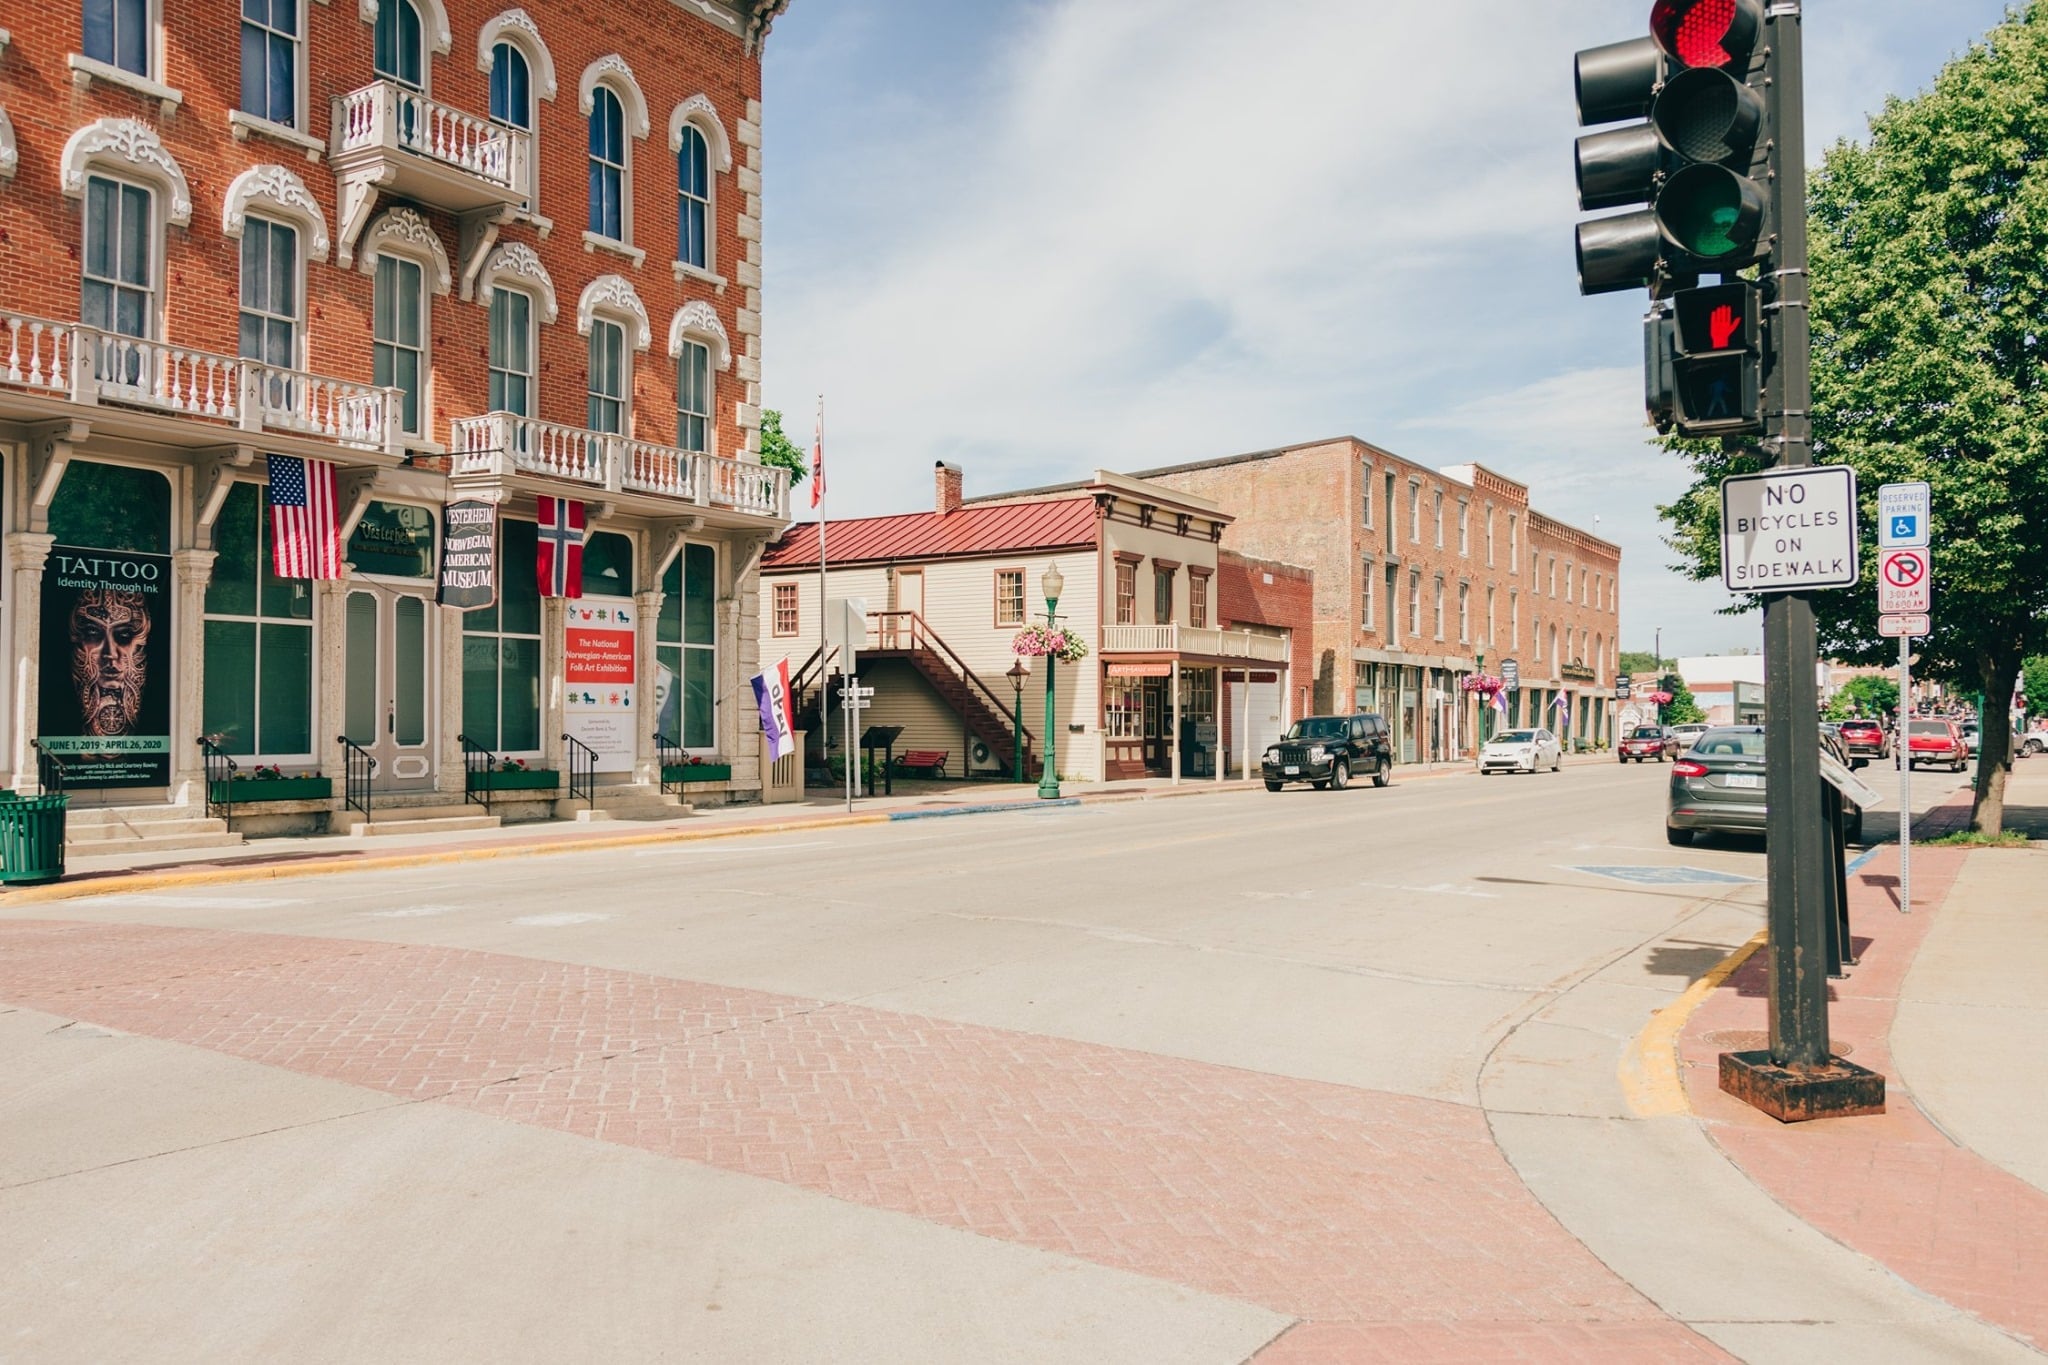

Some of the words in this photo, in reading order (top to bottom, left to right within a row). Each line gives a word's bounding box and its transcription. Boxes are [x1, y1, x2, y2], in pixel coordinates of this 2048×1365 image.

[1766, 483, 1806, 506] NO
[1882, 492, 1925, 503] RESERVED
[446, 507, 493, 524] VESTERHEIM
[1885, 503, 1922, 514] PARKING
[1737, 511, 1839, 533] BICYCLES
[444, 535, 492, 552] NORWEGIAN
[1775, 537, 1802, 553] ON
[56, 556, 158, 580] TATTOO
[443, 553, 492, 567] AMERICAN
[1736, 558, 1843, 580] SIDEWALK
[57, 577, 98, 591] Identity
[99, 580, 141, 594] Through
[143, 584, 159, 593] Ink
[441, 569, 493, 589] MUSEUM
[1912, 599, 1924, 608] AM
[579, 638, 591, 648] The
[592, 639, 620, 649] National
[566, 650, 632, 663] Norwegian-American
[570, 663, 584, 673] Folk
[584, 664, 595, 673] Art
[596, 663, 627, 673] Exhibition
[771, 684, 788, 738] OPEN
[48, 741, 70, 750] JUNE
[71, 741, 79, 751] 1,
[80, 741, 100, 749] 2019
[105, 741, 128, 749] APRIL
[130, 741, 142, 750] 26,
[143, 741, 162, 749] 2020
